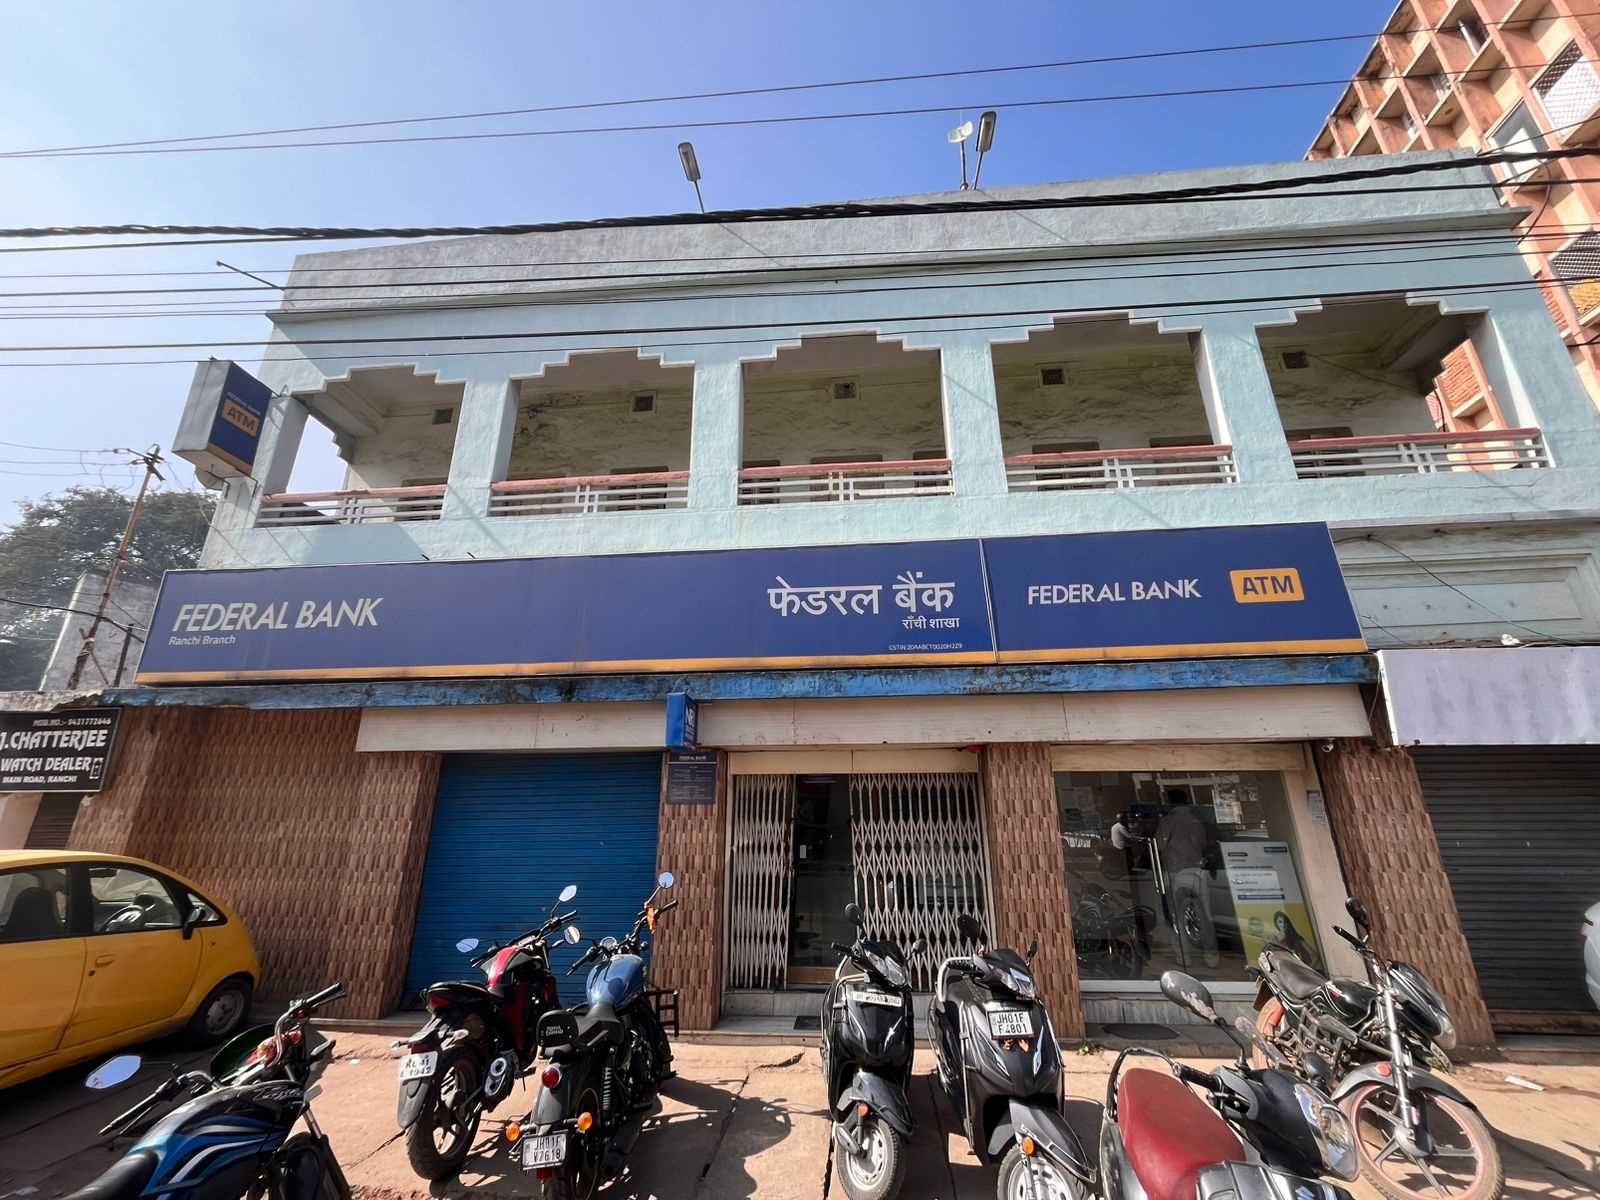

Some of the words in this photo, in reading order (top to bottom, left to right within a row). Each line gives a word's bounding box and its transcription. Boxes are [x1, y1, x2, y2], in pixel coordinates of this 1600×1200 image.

[227, 407, 256, 432] ATM
[767, 575, 883, 617] फेडरल
[892, 570, 956, 613] बैंक
[1028, 581, 1126, 605] FEDERAL
[1131, 578, 1203, 601] BANK
[1242, 575, 1295, 596] ATM
[172, 601, 289, 632] FEDERAL
[295, 597, 384, 629] BANK
[902, 615, 927, 629] राँची
[929, 617, 960, 629] शाखा
[168, 636, 201, 646] Ranchi
[202, 634, 236, 645] Branch
[0, 757, 43, 772] WATCH
[44, 757, 92, 772] DEALER
[47, 775, 78, 783] RANCHI
[997, 1012, 1024, 1024] JH01F
